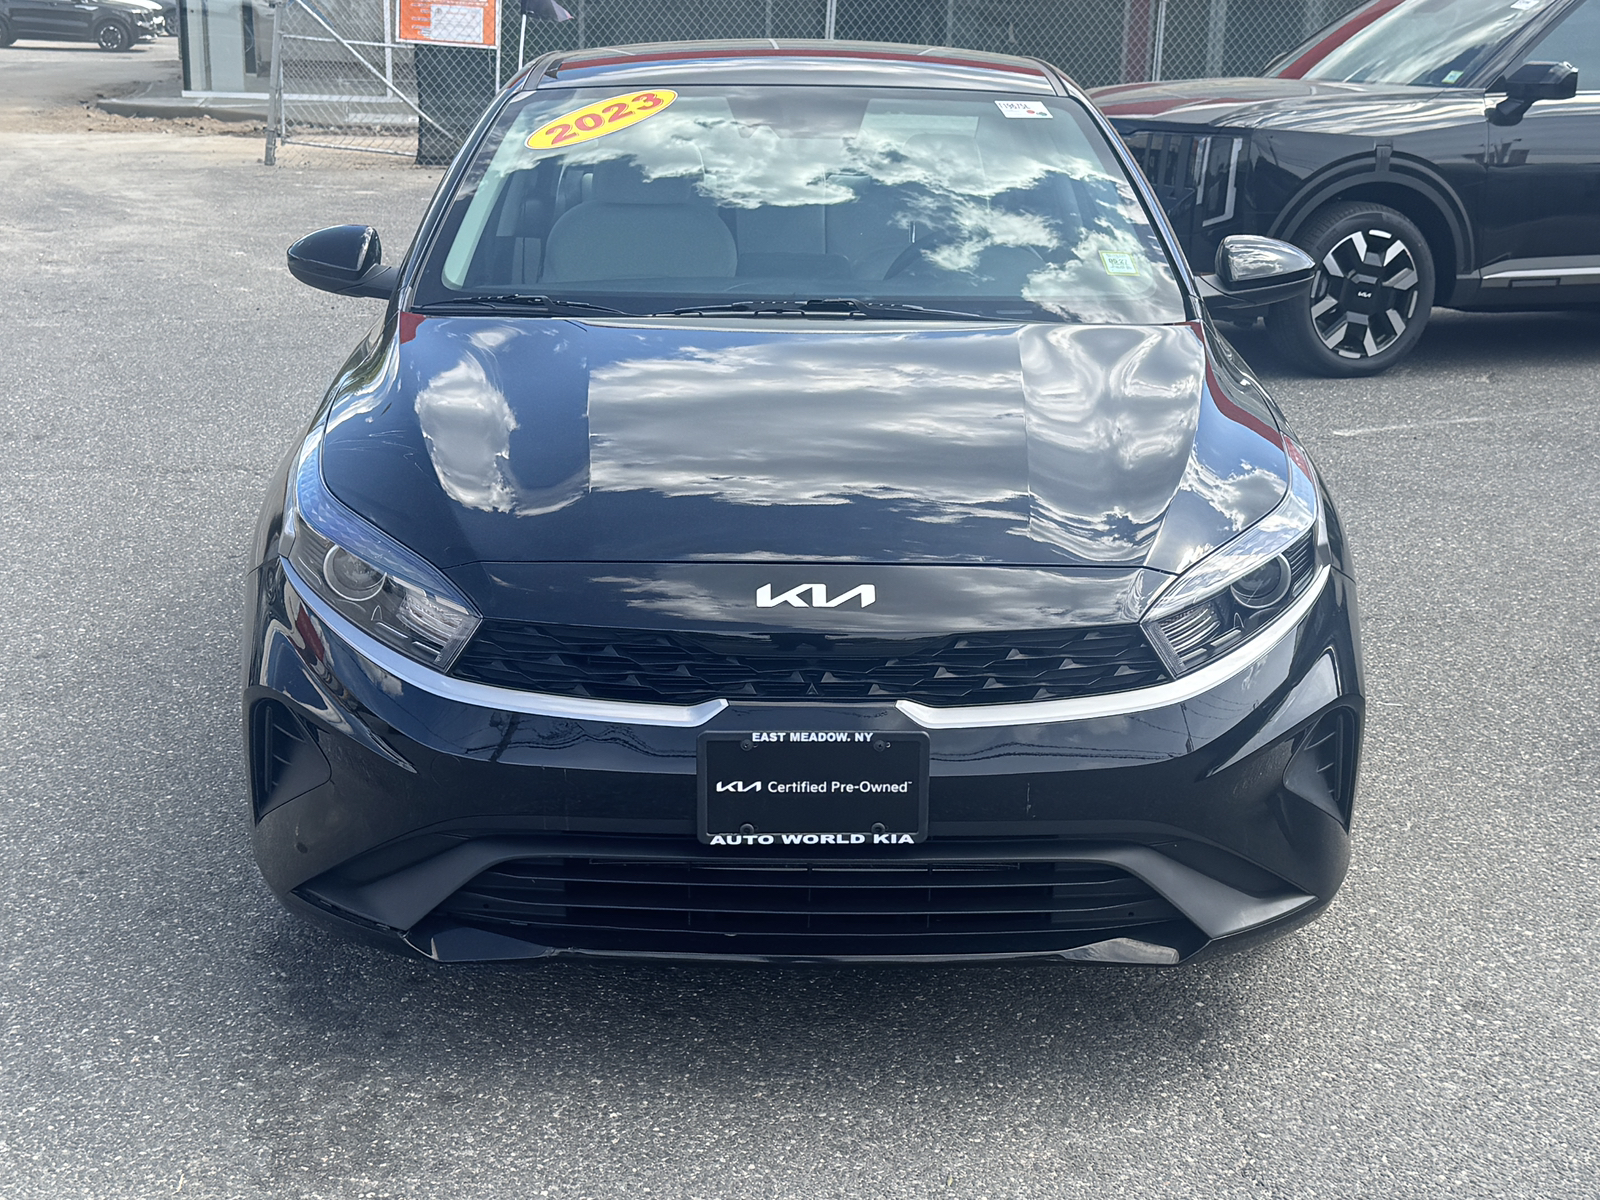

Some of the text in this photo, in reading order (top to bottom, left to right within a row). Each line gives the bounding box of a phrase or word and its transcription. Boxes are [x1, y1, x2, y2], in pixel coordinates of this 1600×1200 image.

[545, 92, 664, 145] 2023
[756, 583, 876, 608] KIA
[752, 733, 786, 742] EAST
[854, 732, 874, 742] NY
[716, 781, 762, 792] KIA
[767, 780, 828, 793] Certified
[709, 834, 914, 846] AUTO WORLD KIA
